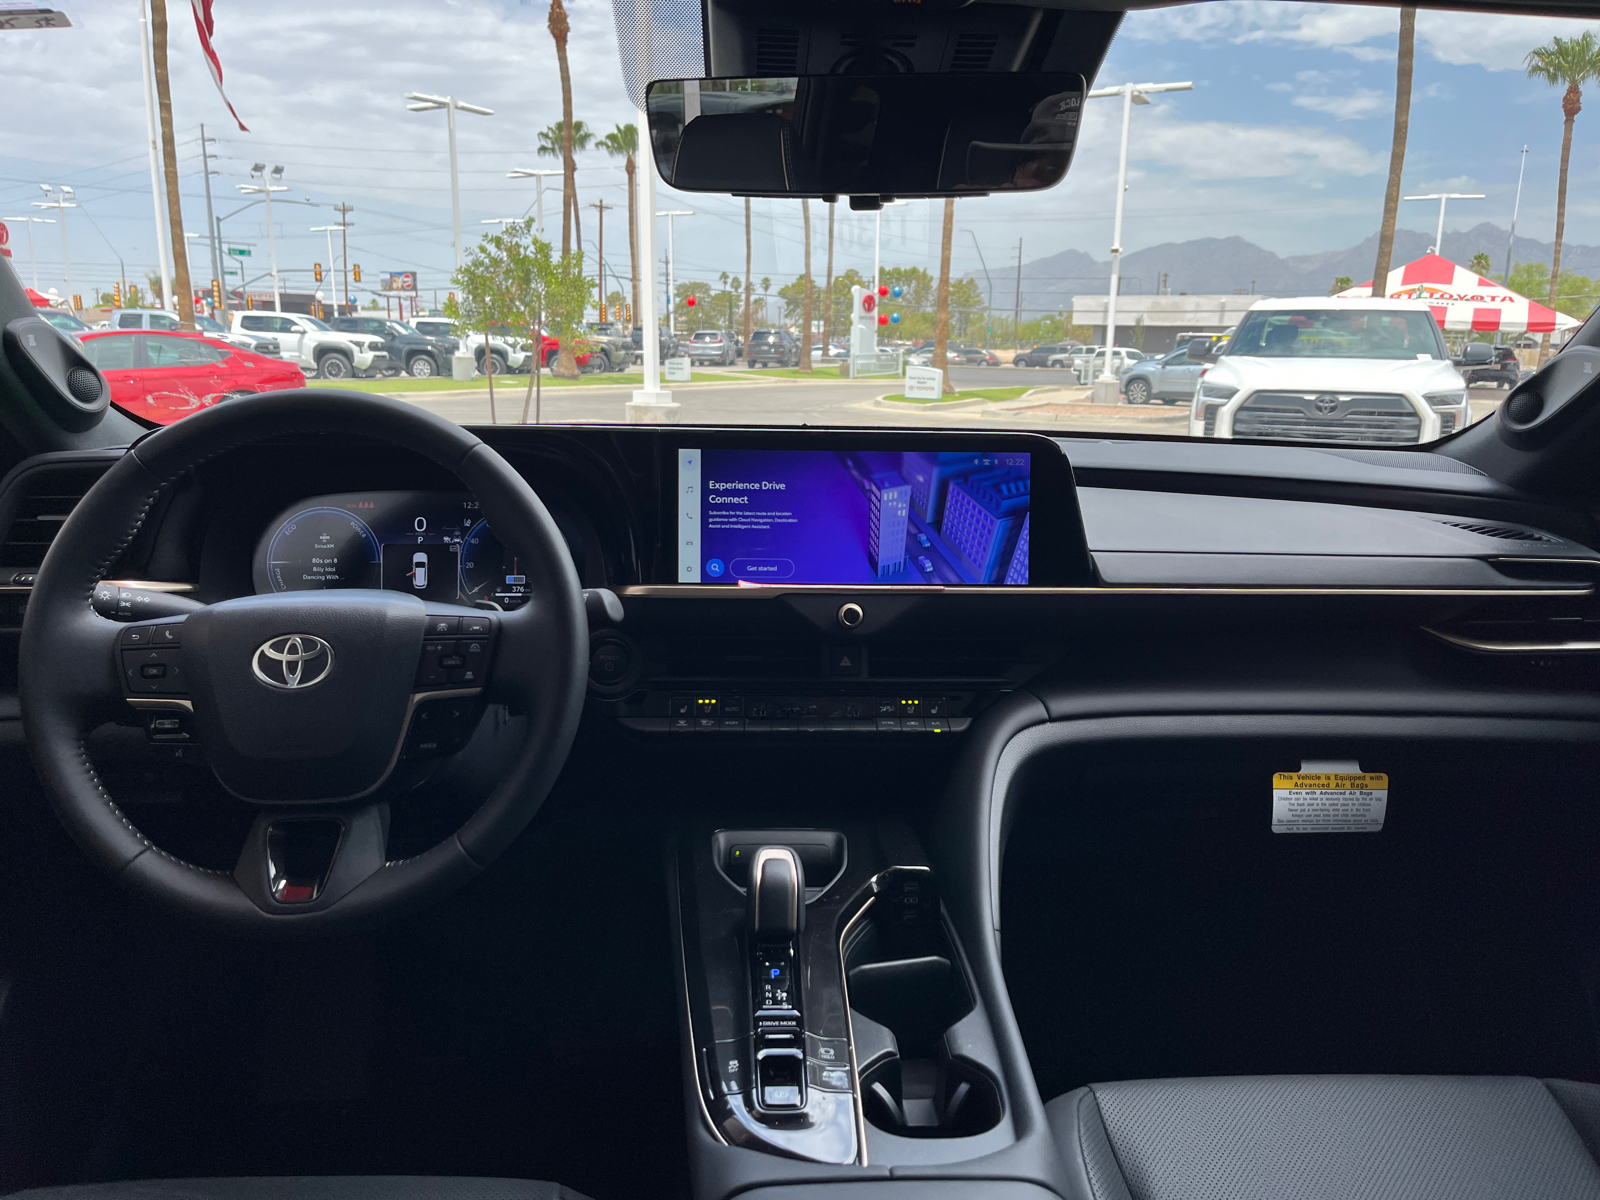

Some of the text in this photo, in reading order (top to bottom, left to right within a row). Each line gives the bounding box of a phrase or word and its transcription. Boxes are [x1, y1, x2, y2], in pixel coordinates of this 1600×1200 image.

[1427, 292, 1515, 303] TOYOTA
[709, 481, 786, 491] Experience Drive
[709, 495, 748, 504] Connect
[350, 521, 367, 538] POWER
[415, 516, 427, 532] 0
[284, 524, 297, 536] ECO
[771, 968, 780, 979] P
